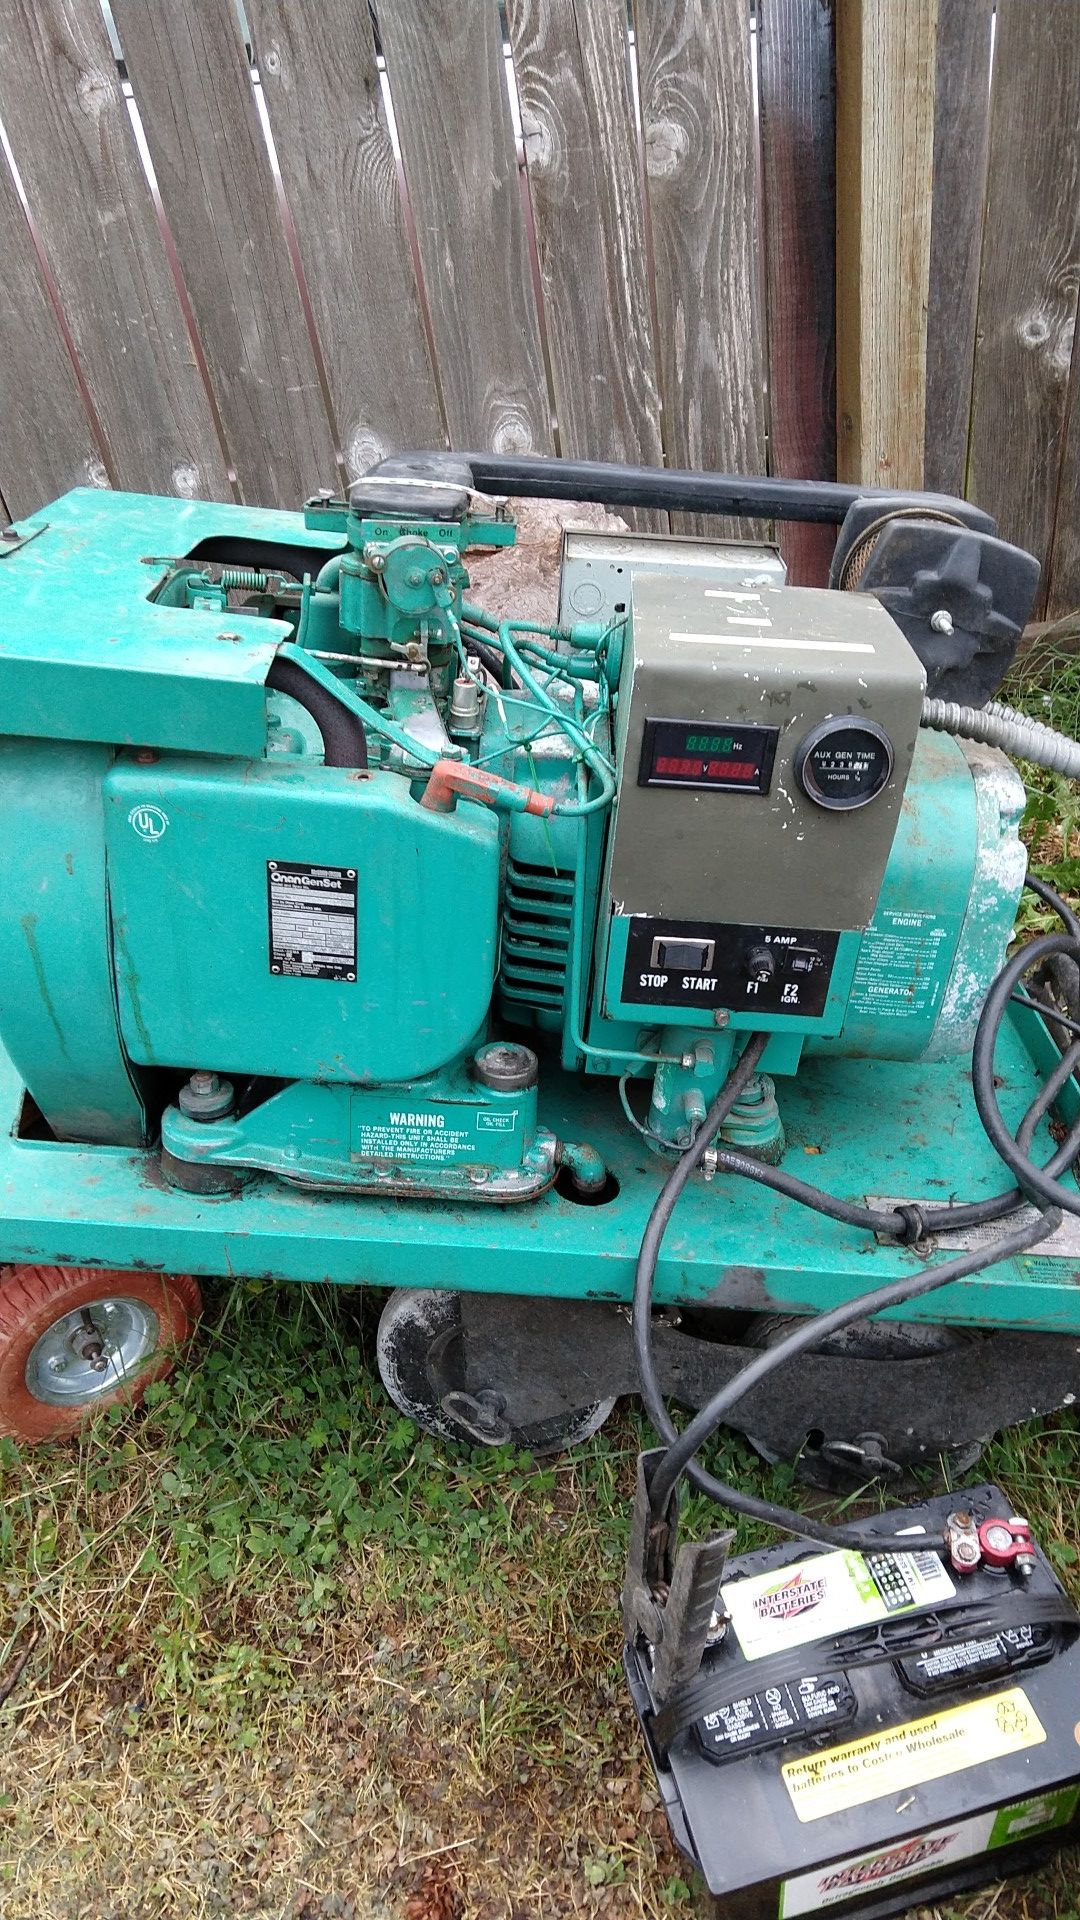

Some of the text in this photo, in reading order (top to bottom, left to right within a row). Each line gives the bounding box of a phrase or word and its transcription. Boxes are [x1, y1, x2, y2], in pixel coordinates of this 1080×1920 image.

[374, 527, 388, 536] On
[400, 526, 429, 537] Choke
[438, 528, 453, 538] Off
[733, 742, 743, 751] Hz
[814, 751, 876, 760] AUX GEN TIME
[754, 768, 760, 776] A
[138, 812, 160, 835] UL
[892, 918, 922, 927] ENGINE
[765, 935, 797, 945] 5 AMP
[640, 974, 668, 988] STOP
[682, 976, 718, 991] START
[746, 981, 759, 994] F1
[783, 983, 799, 997] F2
[780, 995, 801, 1004] IGN.
[390, 1112, 445, 1128] WARNING
[372, 1126, 404, 1134] PREVENT
[406, 1127, 421, 1135] FIRE
[434, 1129, 469, 1138] ACCIDENT
[361, 1138, 399, 1147] INSTALLED
[400, 1140, 419, 1148] ONLY
[430, 1142, 476, 1151] ACCORDANCE
[426, 1135, 448, 1143] SHALL
[361, 1150, 394, 1158] DETAILED
[396, 1146, 456, 1156] MANUFACTURERS
[753, 1578, 826, 1609] INTERSTATE
[759, 1589, 825, 1618] BATTERIES
[827, 1685, 840, 1696] ACID
[732, 1698, 752, 1710] SHIELD
[772, 1703, 781, 1712] NO
[787, 1720, 938, 1778] Return warranty and used
[793, 1769, 845, 1793] batteries
[847, 1764, 859, 1774] to
[905, 1728, 966, 1754] Wholesale
